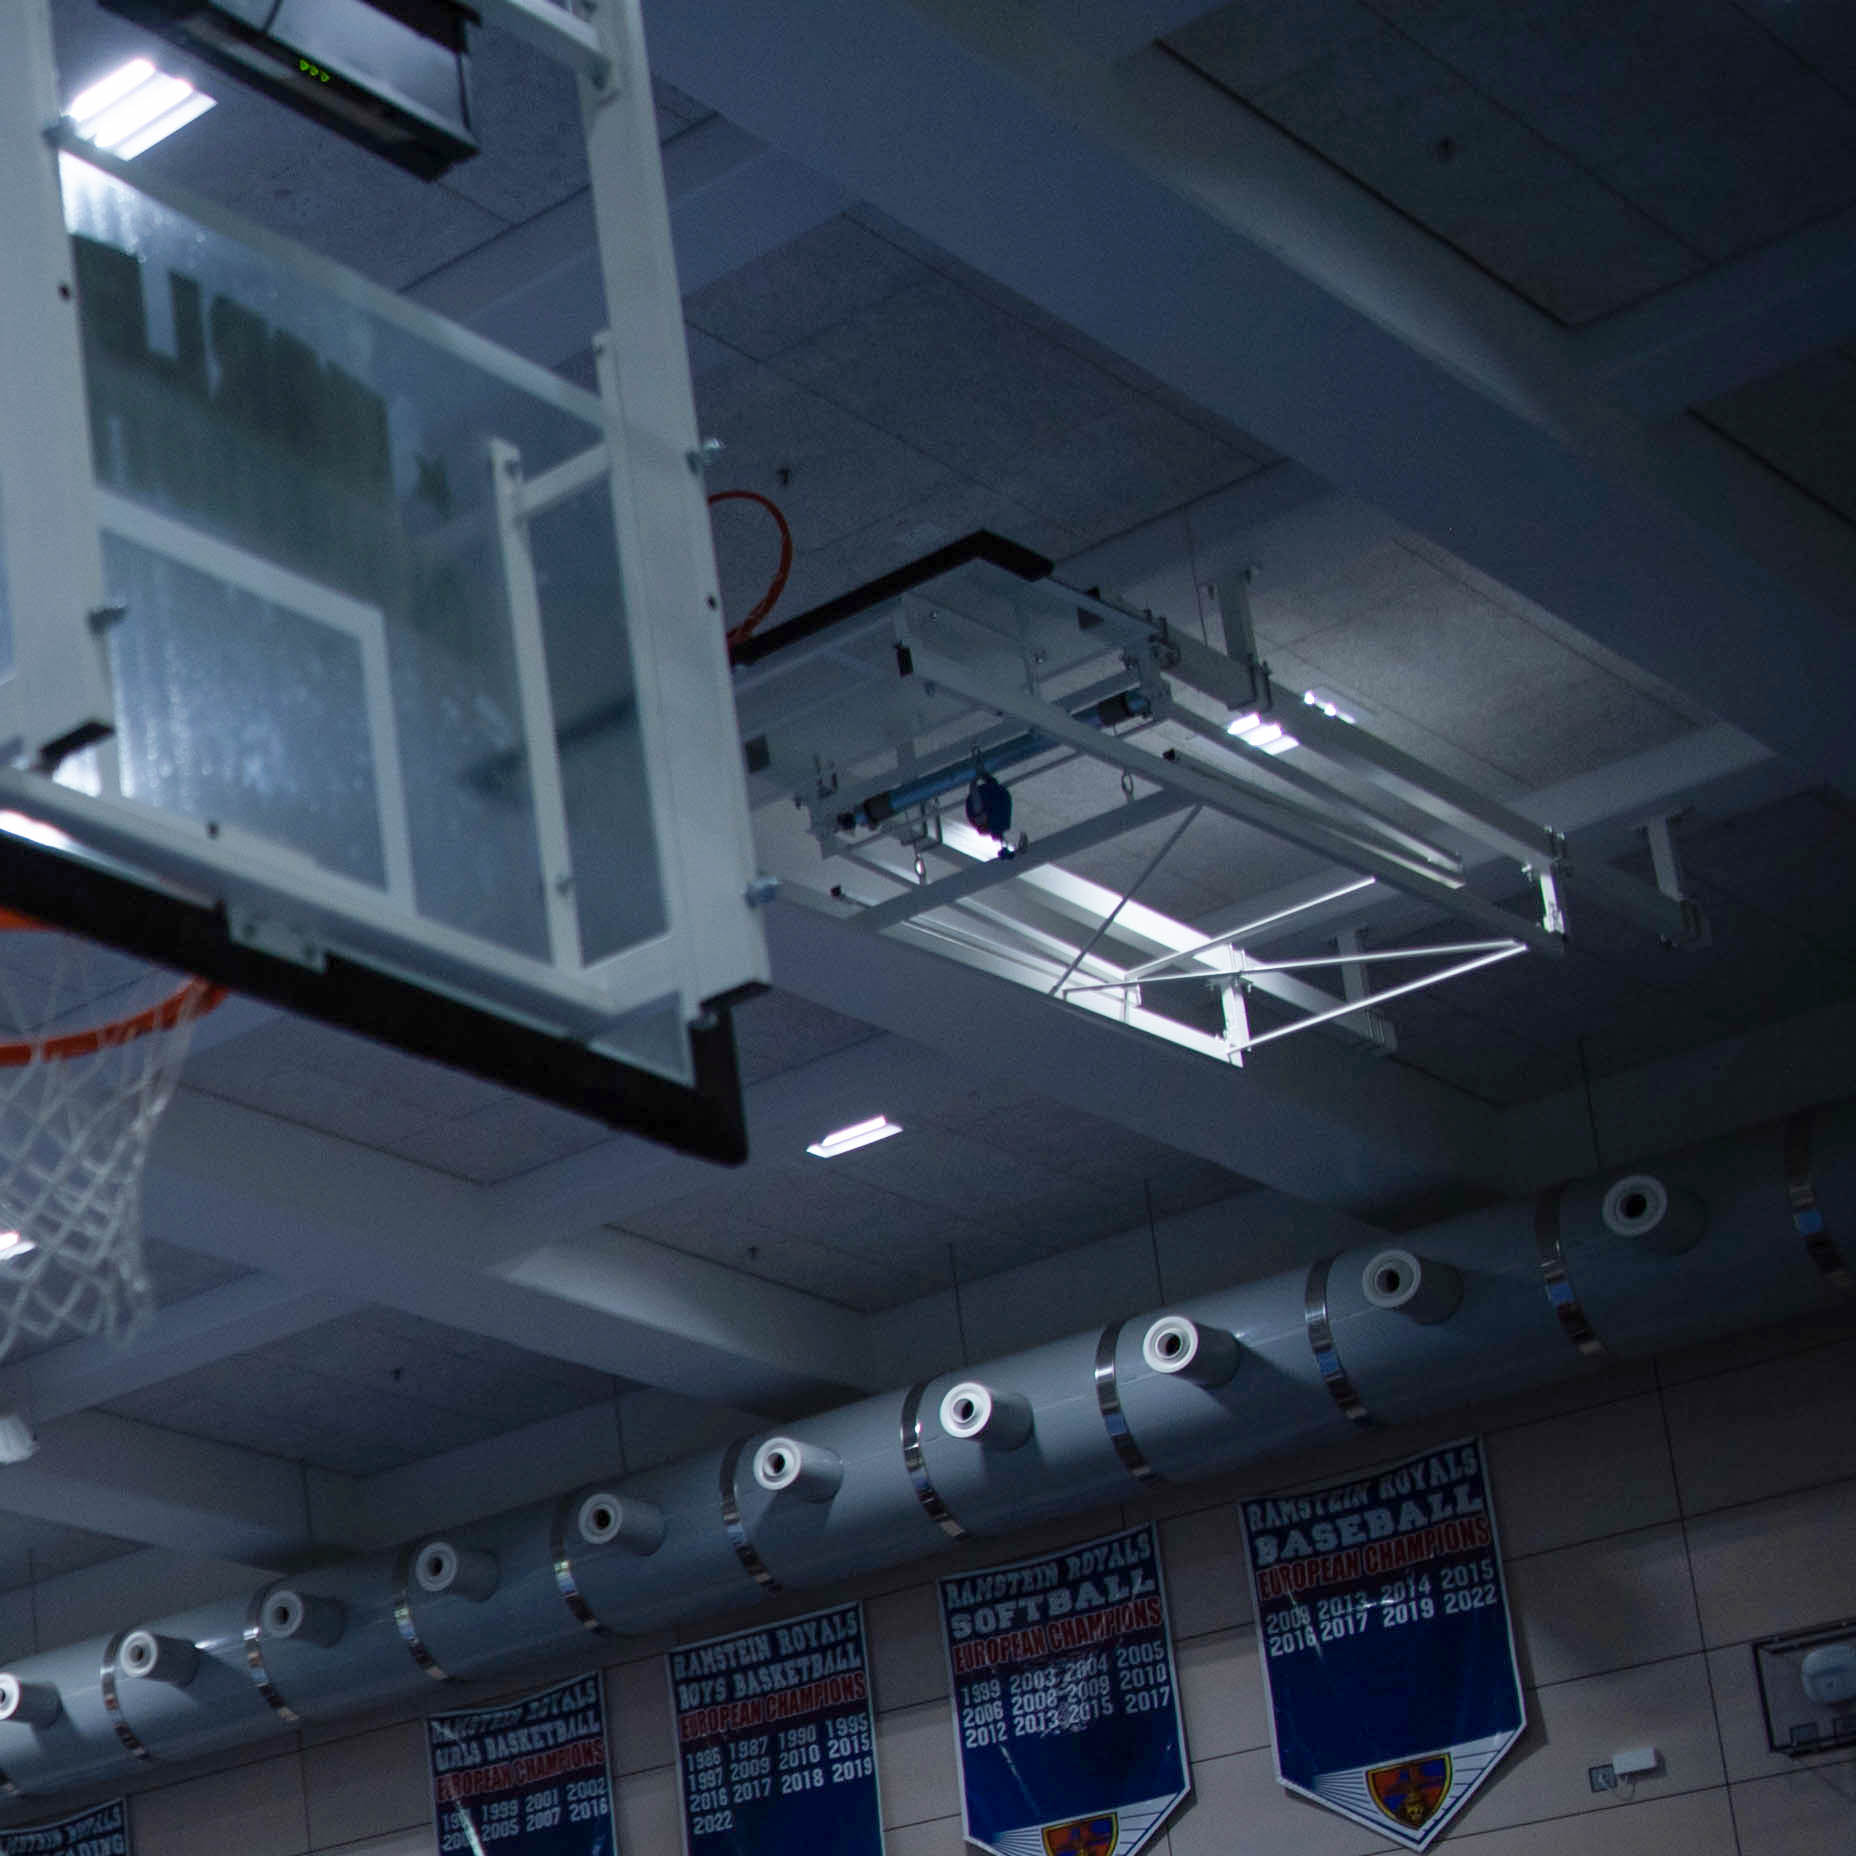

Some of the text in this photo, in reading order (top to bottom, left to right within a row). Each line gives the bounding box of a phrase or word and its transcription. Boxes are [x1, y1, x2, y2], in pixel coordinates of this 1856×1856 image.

[1247, 1447, 1479, 1531] RAMSTEIN ROYALS
[1255, 1480, 1484, 1567] BASEBALL
[945, 1531, 1151, 1610] RAMSTEIN ROYALS
[1258, 1515, 1491, 1601] EUROPEAN CHAMPIONS
[1440, 1559, 1495, 1590] 2015
[951, 1568, 1155, 1640] SOFTBALL
[954, 1597, 1161, 1673] EUROPEAN CHAMPIONS
[1268, 1584, 1497, 1657] 2016 2017 2019 2022
[674, 1610, 858, 1680] RAMSTEIN ROYALS
[1116, 1641, 1165, 1668] 2005
[679, 1642, 861, 1712] BOYS BASKETBALL
[681, 1671, 865, 1739] EUROPEAN CHAMPIONS
[1119, 1663, 1167, 1691] 2010
[483, 1709, 600, 1759] BASKETBALL
[828, 1734, 870, 1759] 2015
[965, 1722, 1007, 1749] 2012
[1125, 1686, 1171, 1713] 2017
[512, 1738, 604, 1783] CHAMPIONS
[566, 1777, 607, 1801] 2002
[733, 1778, 771, 1803] 2017
[781, 1769, 824, 1794] 2018
[832, 1757, 872, 1783] 2019
[525, 1807, 560, 1831] 2007
[693, 1810, 733, 1835] 2022
